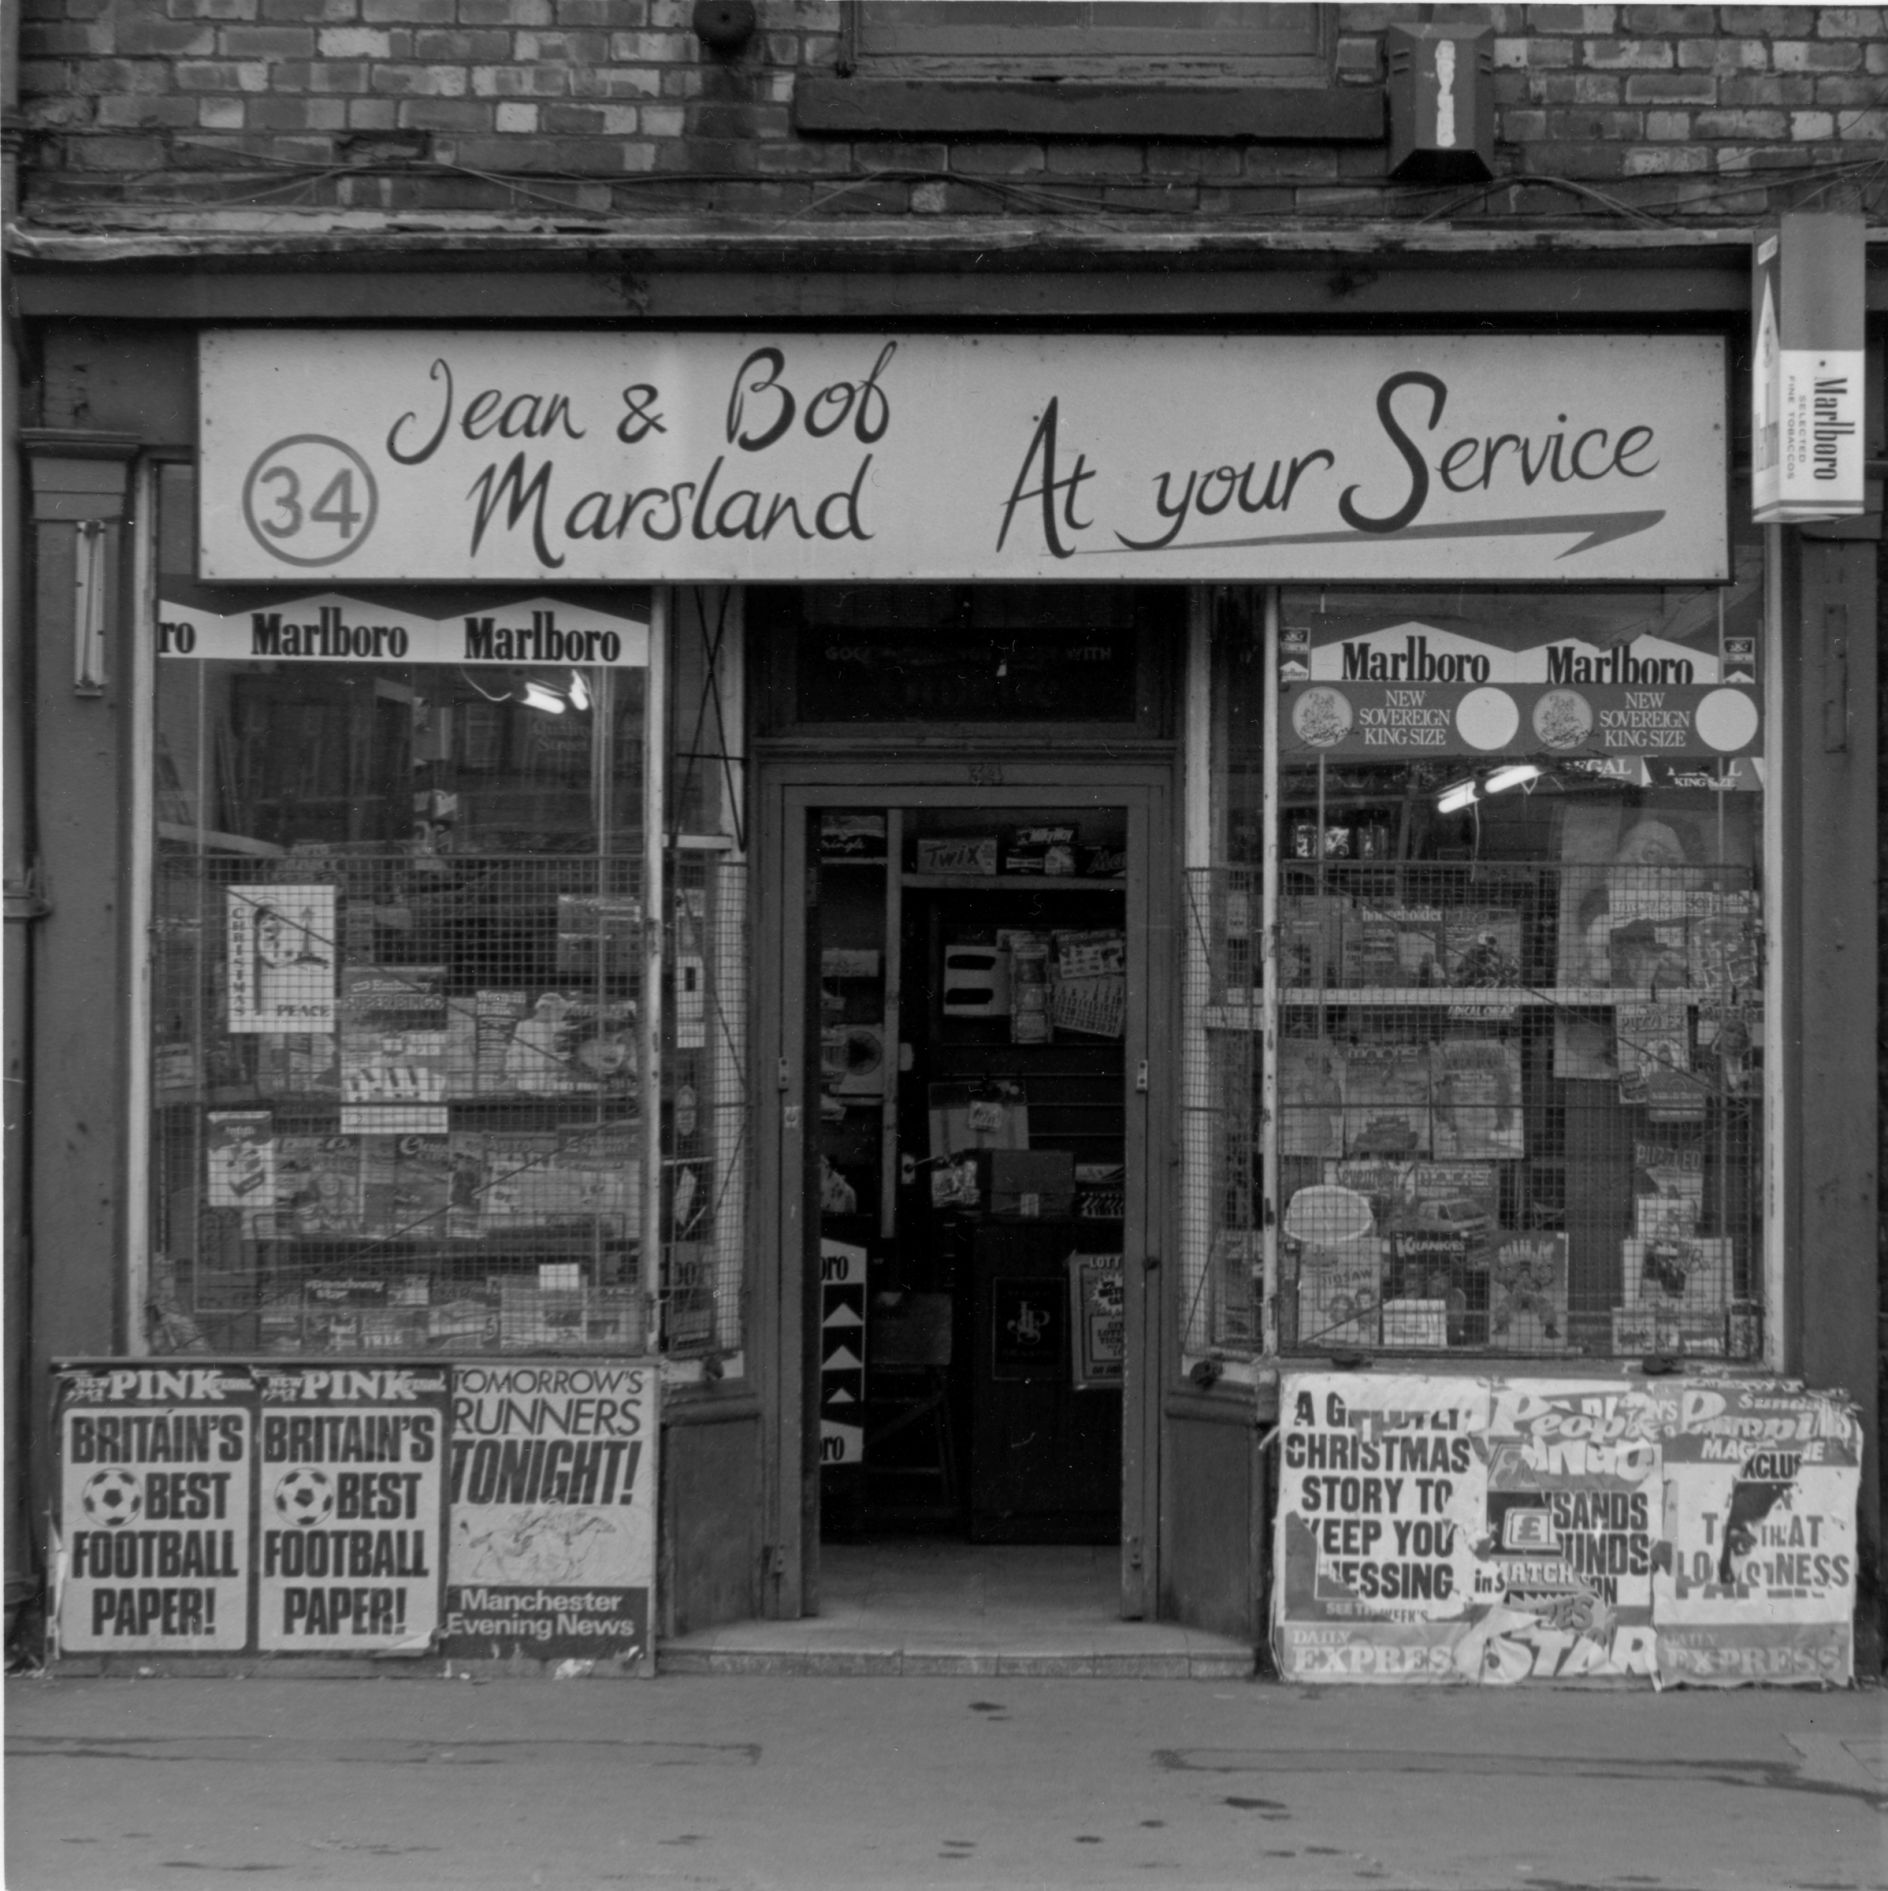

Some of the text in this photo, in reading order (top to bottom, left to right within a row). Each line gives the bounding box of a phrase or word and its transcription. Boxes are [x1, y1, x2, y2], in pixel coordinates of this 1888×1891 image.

[387, 340, 897, 466] Jean & Bob
[1786, 374, 1796, 481] FINE TOBACCOS
[1799, 394, 1807, 464] SELECTED
[1813, 376, 1856, 481] Marlboro
[996, 370, 1661, 559] At your Service
[259, 465, 362, 540] 34
[465, 451, 875, 569] Marsland
[251, 606, 409, 657] Marlboro
[463, 610, 621, 663] Marlboro
[1341, 635, 1491, 683] Marlboro
[1546, 644, 1694, 685] Marlboro
[1359, 708, 1451, 727] SOVEREIGN
[1385, 690, 1427, 708] NEW
[1600, 710, 1690, 728] SOVEREIGN
[1624, 691, 1666, 709] NEW
[1363, 728, 1447, 746] KING SIZE
[1604, 730, 1686, 748] KING SIZE
[1673, 777, 1708, 788] KING
[1362, 905, 1443, 922] householder
[231, 907, 246, 1017] CHRISTMAS
[276, 1004, 332, 1018] PEACE
[106, 1369, 227, 1400] PINK
[301, 1369, 418, 1400] PINK
[452, 1368, 643, 1395] TOMORROW'S
[451, 1397, 643, 1437] RUNNERS
[1294, 1390, 1316, 1427] A
[71, 1414, 243, 1464] BRITAIN'S
[264, 1414, 435, 1464] BRITAIN'S
[1286, 1433, 1471, 1474] CHRISTMAS
[450, 1438, 643, 1506] TONIGHT!
[144, 1471, 231, 1520] BEST
[336, 1471, 422, 1520] BEST
[1301, 1475, 1404, 1514] STORY
[71, 1529, 239, 1579] FOOTBALL
[264, 1529, 429, 1578] FOOTBALL
[1392, 1518, 1458, 1558] YOU
[1557, 1532, 1649, 1576] UNDS
[92, 1587, 217, 1636] PAPER!
[283, 1586, 407, 1636] PAPER!
[460, 1588, 623, 1612] Manchester
[447, 1612, 635, 1641] Evening News
[1292, 1629, 1350, 1645] DAILY
[1292, 1644, 1456, 1674] EXPRES
